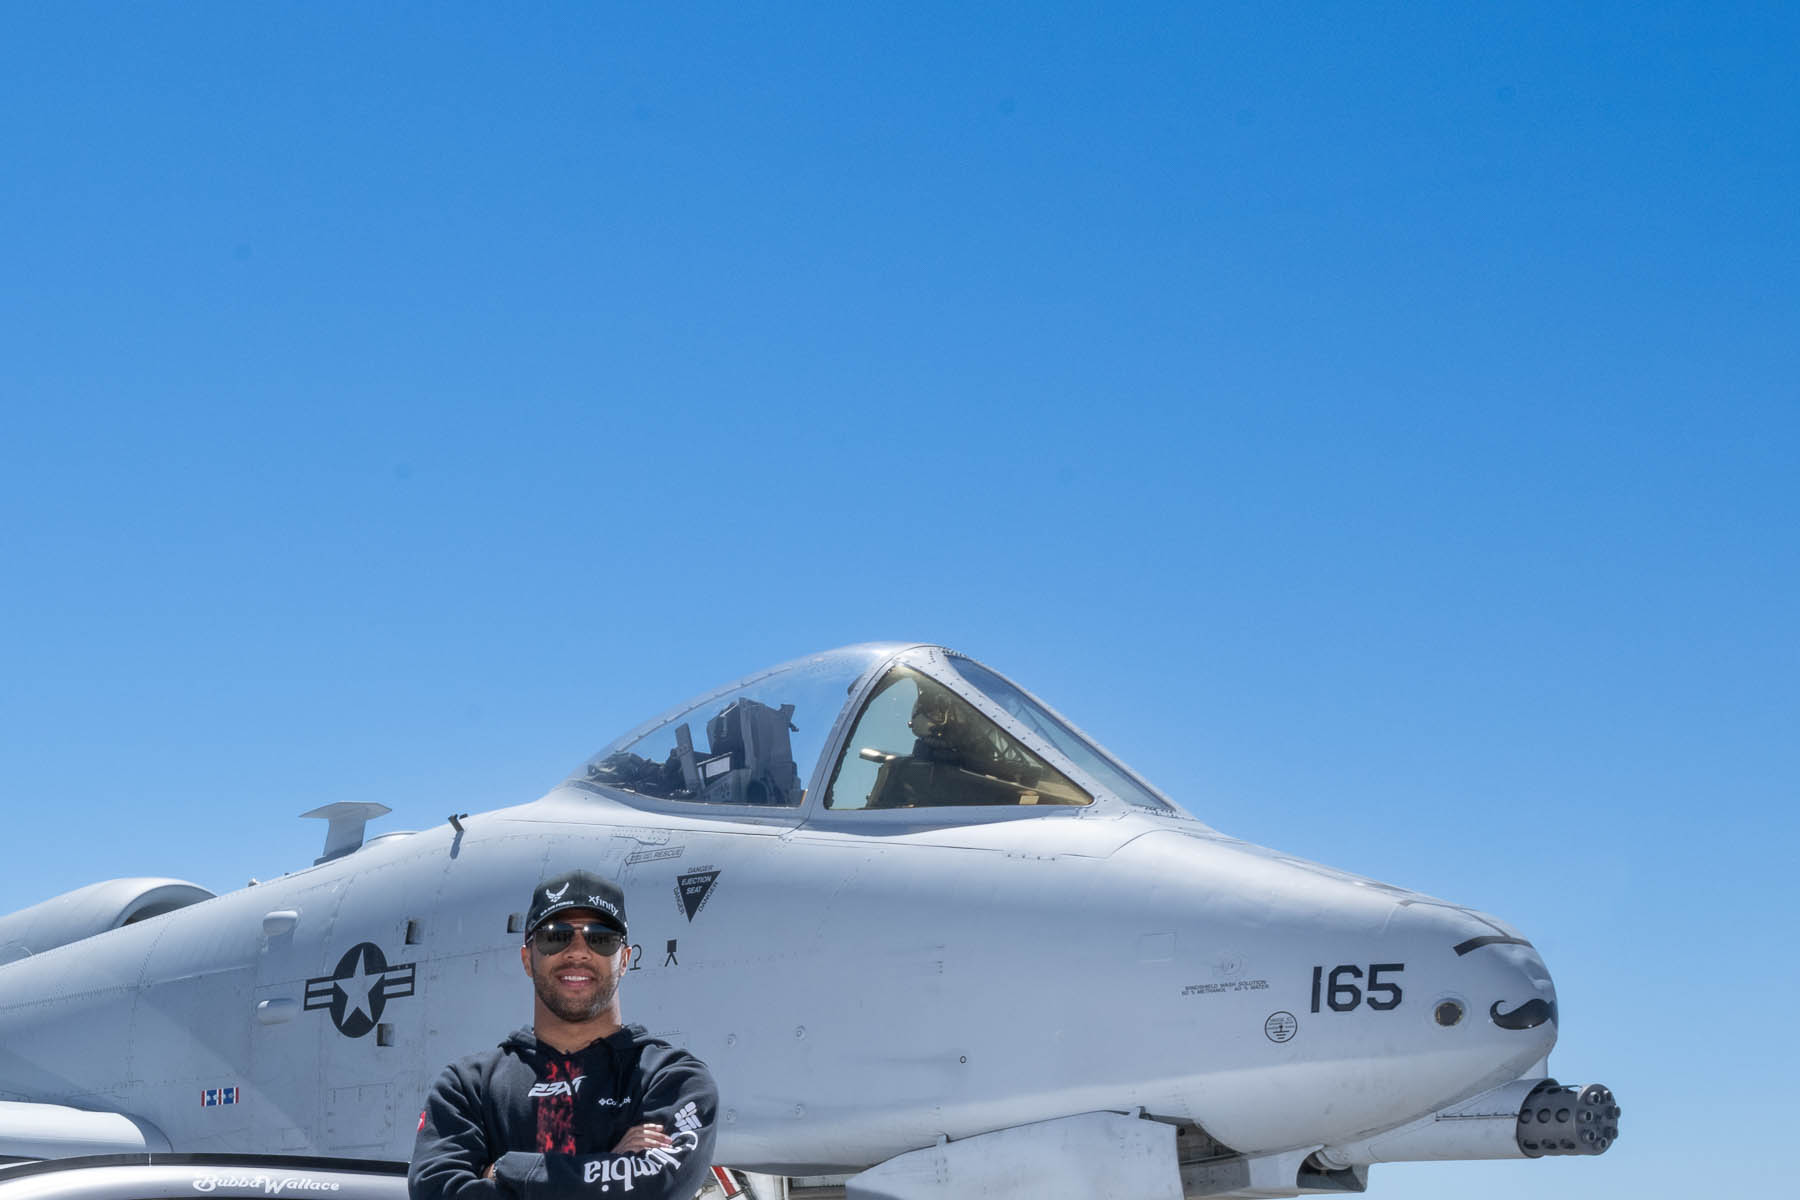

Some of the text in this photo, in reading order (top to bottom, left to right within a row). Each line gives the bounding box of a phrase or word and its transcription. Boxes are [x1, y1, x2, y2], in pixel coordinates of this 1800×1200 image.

[688, 865, 714, 873] DANGER
[681, 876, 712, 886] EJECTION
[686, 886, 702, 895] SEAT
[588, 896, 619, 916] xfinity
[1311, 964, 1405, 1013] 165
[193, 1174, 340, 1194] Bubba Wallace
